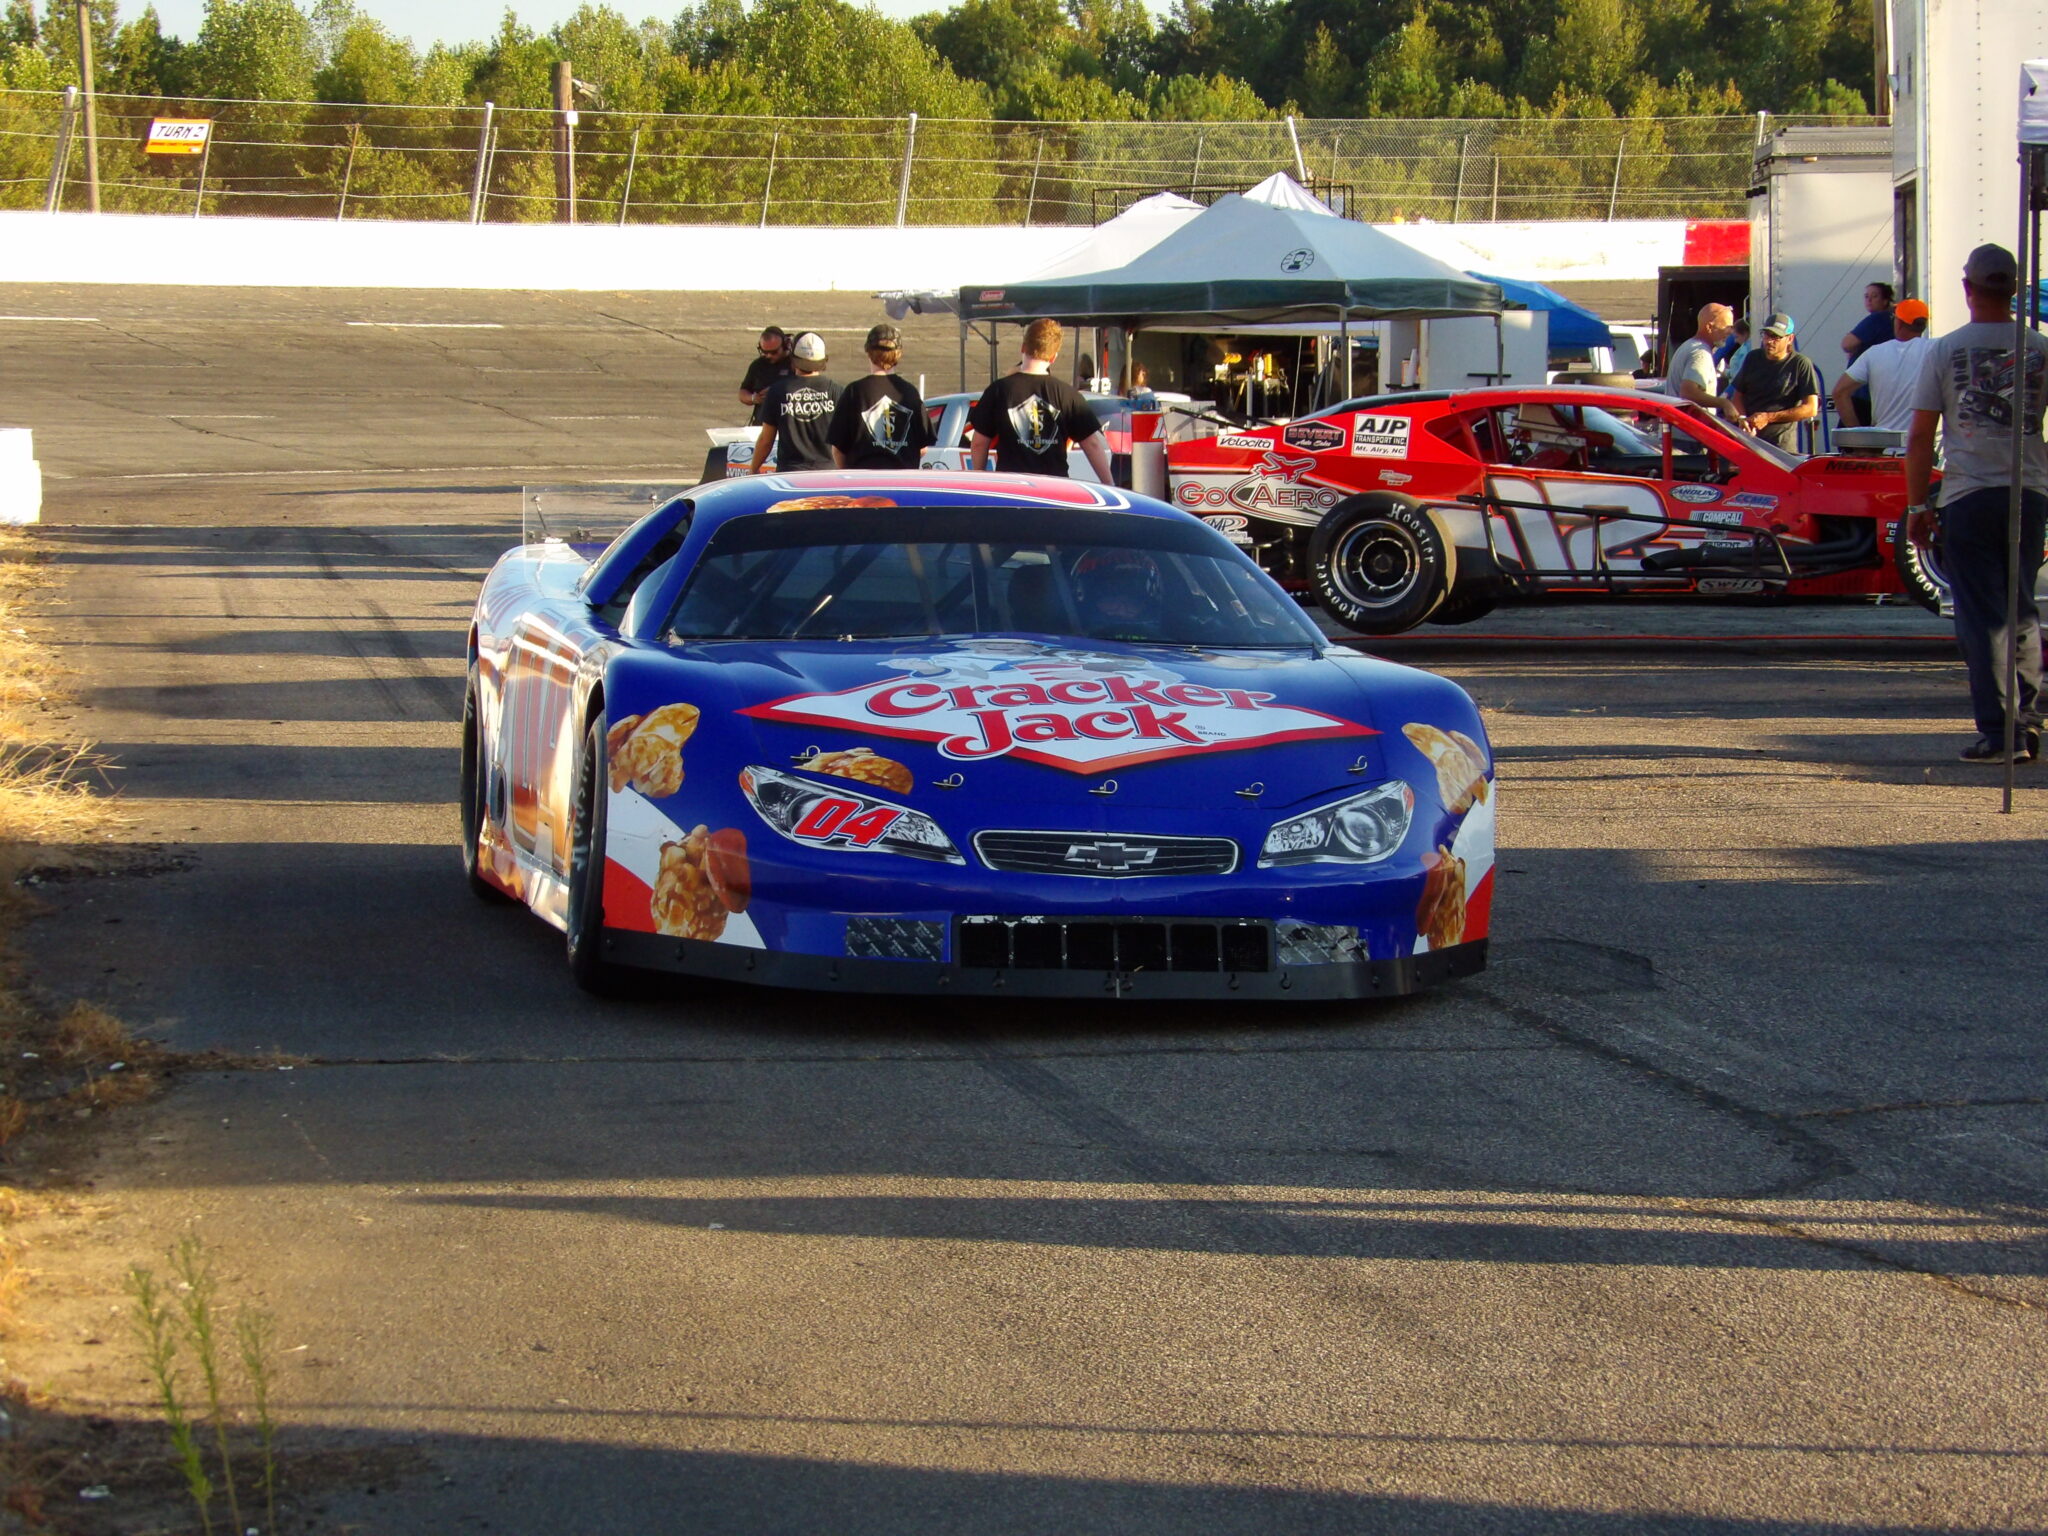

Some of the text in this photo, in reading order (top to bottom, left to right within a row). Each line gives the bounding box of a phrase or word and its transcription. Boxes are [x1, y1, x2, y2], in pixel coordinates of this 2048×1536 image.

[157, 125, 205, 139] TURN 2
[1355, 434, 1392, 445] TRANSPORT
[1358, 418, 1407, 434] AJP
[1387, 502, 1435, 565] Hoosier
[1315, 562, 1364, 622] Hoosier
[865, 676, 1274, 719] Cracker
[943, 704, 1208, 758] Jack
[792, 797, 908, 849] 04
